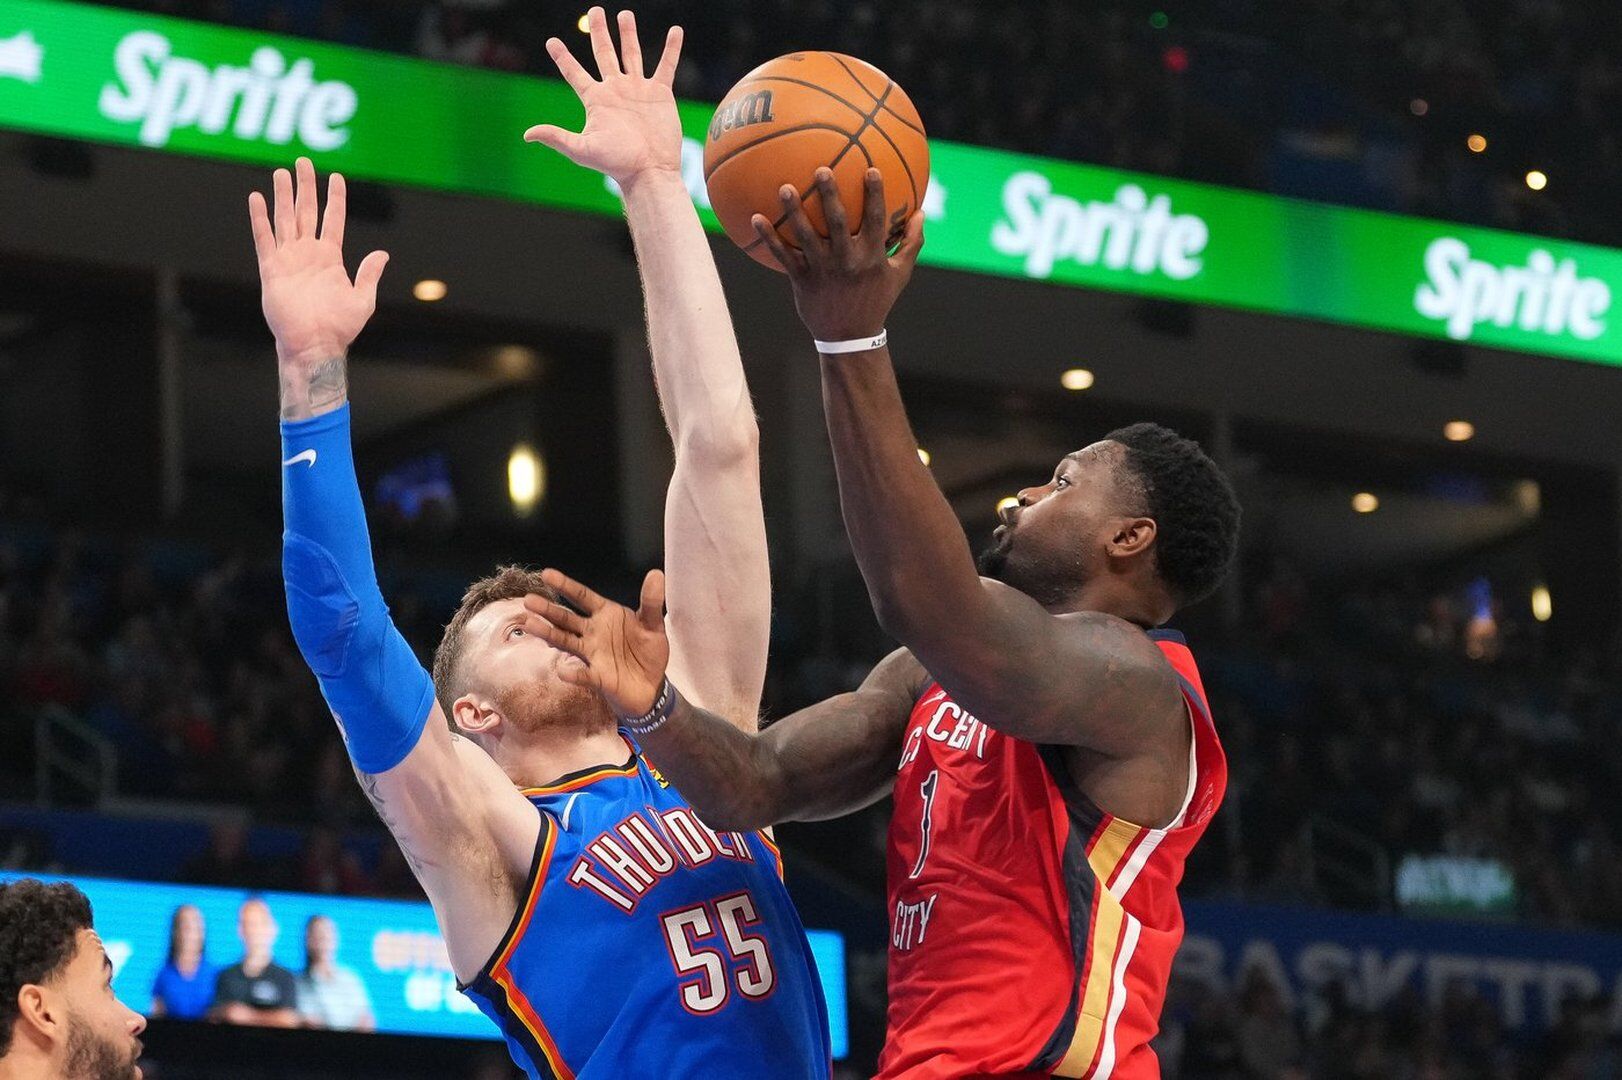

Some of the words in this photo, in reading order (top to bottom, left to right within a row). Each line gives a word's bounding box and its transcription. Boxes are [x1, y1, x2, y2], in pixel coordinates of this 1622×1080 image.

[98, 29, 358, 152] Sprite
[990, 170, 1208, 280] Sprite
[1412, 237, 1611, 341] Sprite
[909, 770, 938, 879] 1
[658, 890, 778, 1017] 55
[893, 893, 937, 951] CITY
